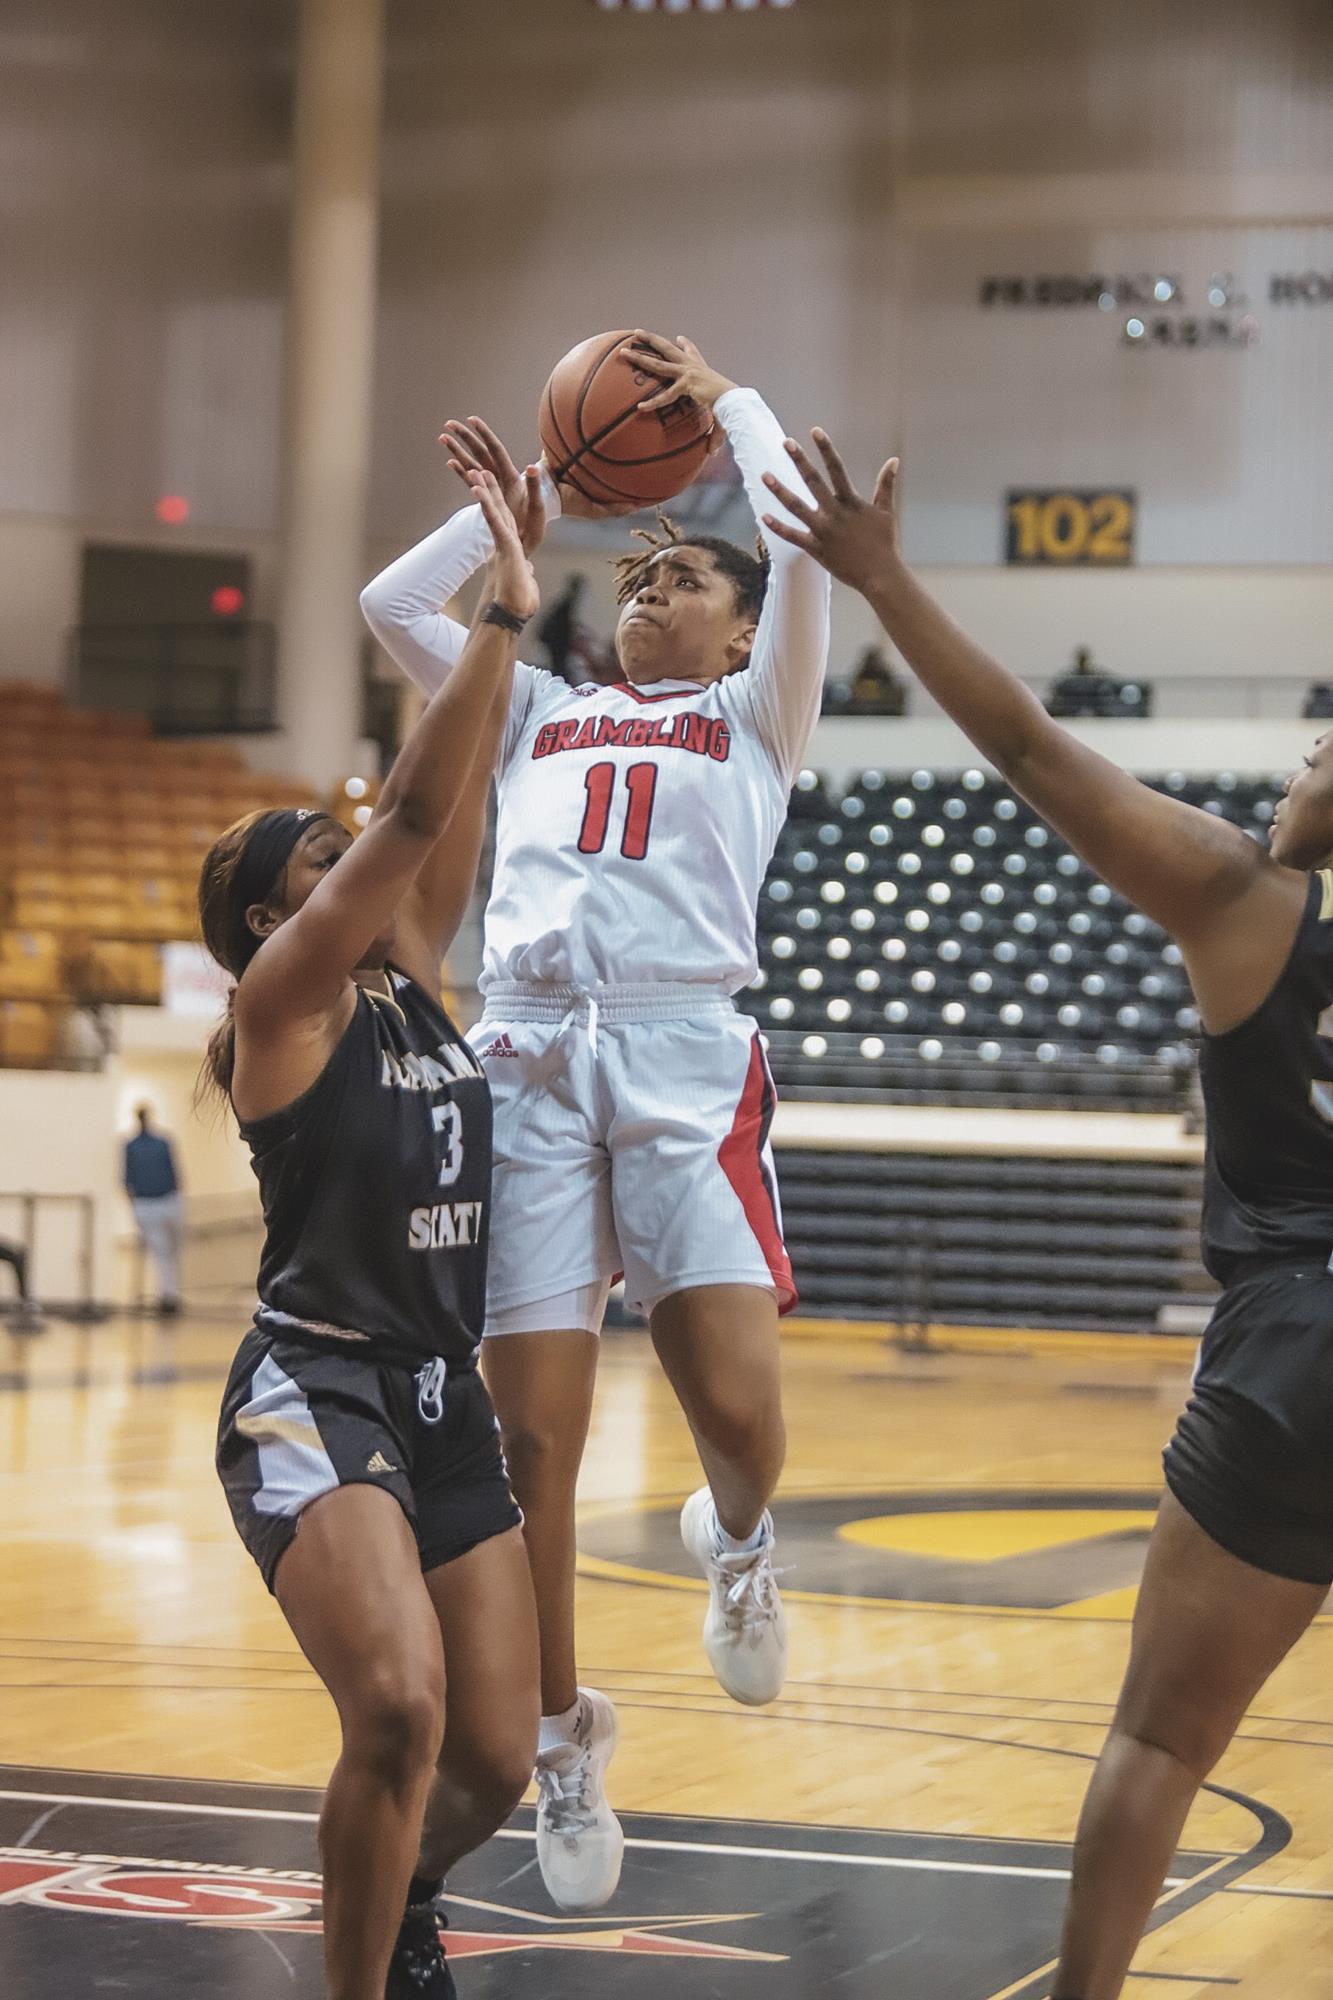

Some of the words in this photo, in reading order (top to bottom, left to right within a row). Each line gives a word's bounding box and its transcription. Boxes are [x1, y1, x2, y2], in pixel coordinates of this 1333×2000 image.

[1012, 496, 1131, 560] 102
[532, 712, 731, 762] GRAMBLING
[577, 761, 658, 860] 11
[483, 1047, 519, 1058] adidas
[432, 1101, 463, 1186] 3
